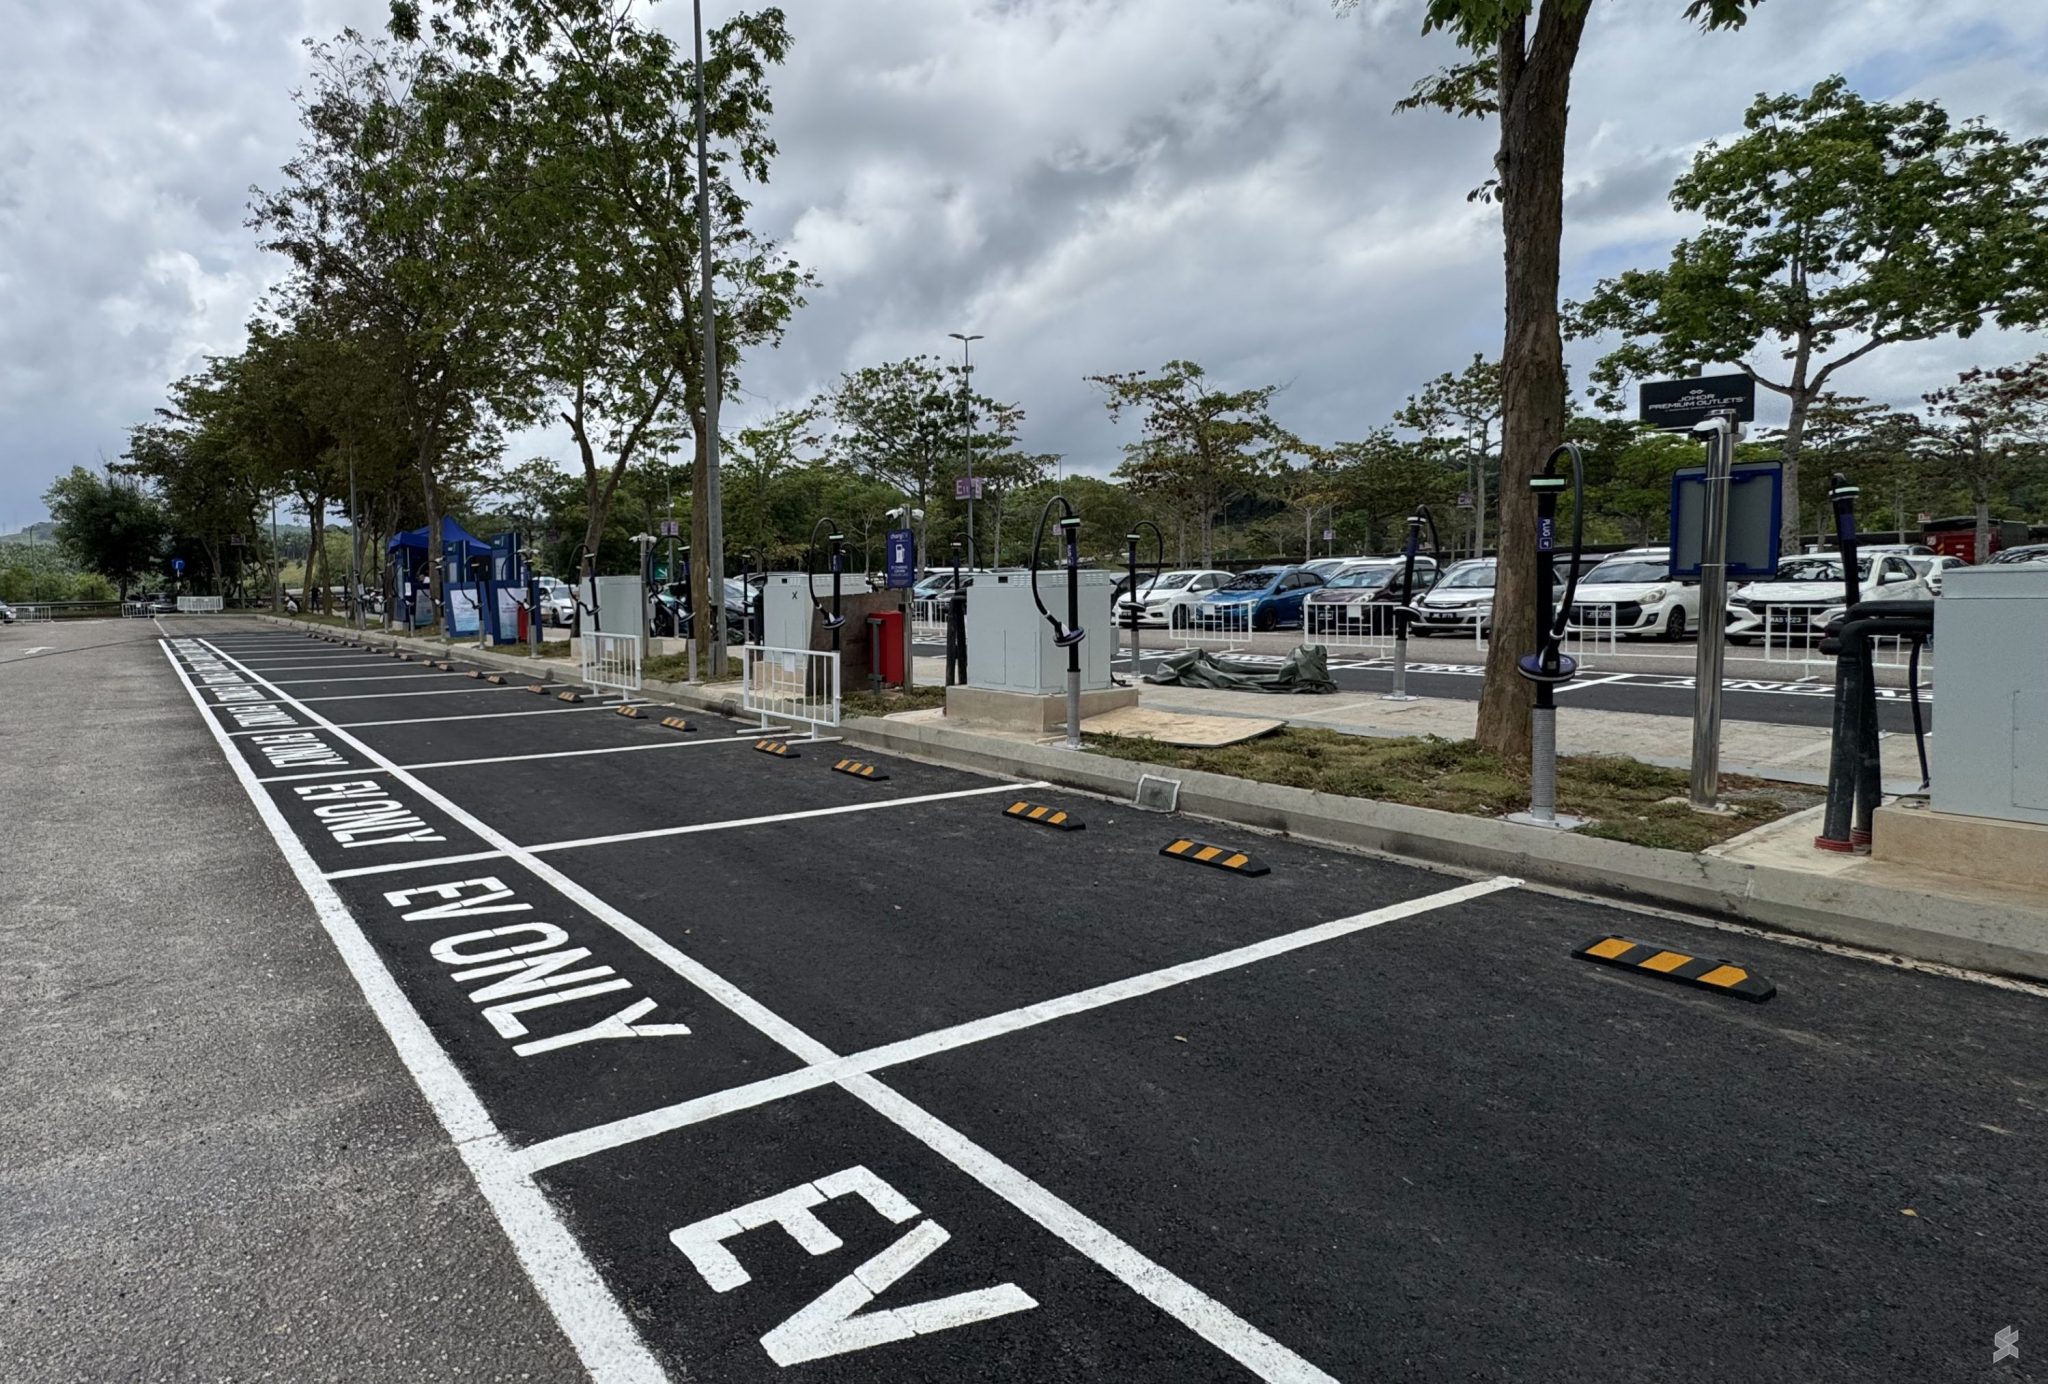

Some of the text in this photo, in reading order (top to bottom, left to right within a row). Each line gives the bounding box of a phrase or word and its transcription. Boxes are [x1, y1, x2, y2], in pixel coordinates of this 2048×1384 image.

[1648, 401, 1695, 411] PREMIUM
[1696, 396, 1744, 406] OUTLETS
[1678, 394, 1716, 403] JOHOR
[1542, 518, 1551, 537] PLUG
[251, 733, 349, 768] EV ONLY
[293, 780, 447, 849] EV ONLY
[383, 876, 692, 1057] EV ONLY
[669, 1164, 1039, 1368] EV
